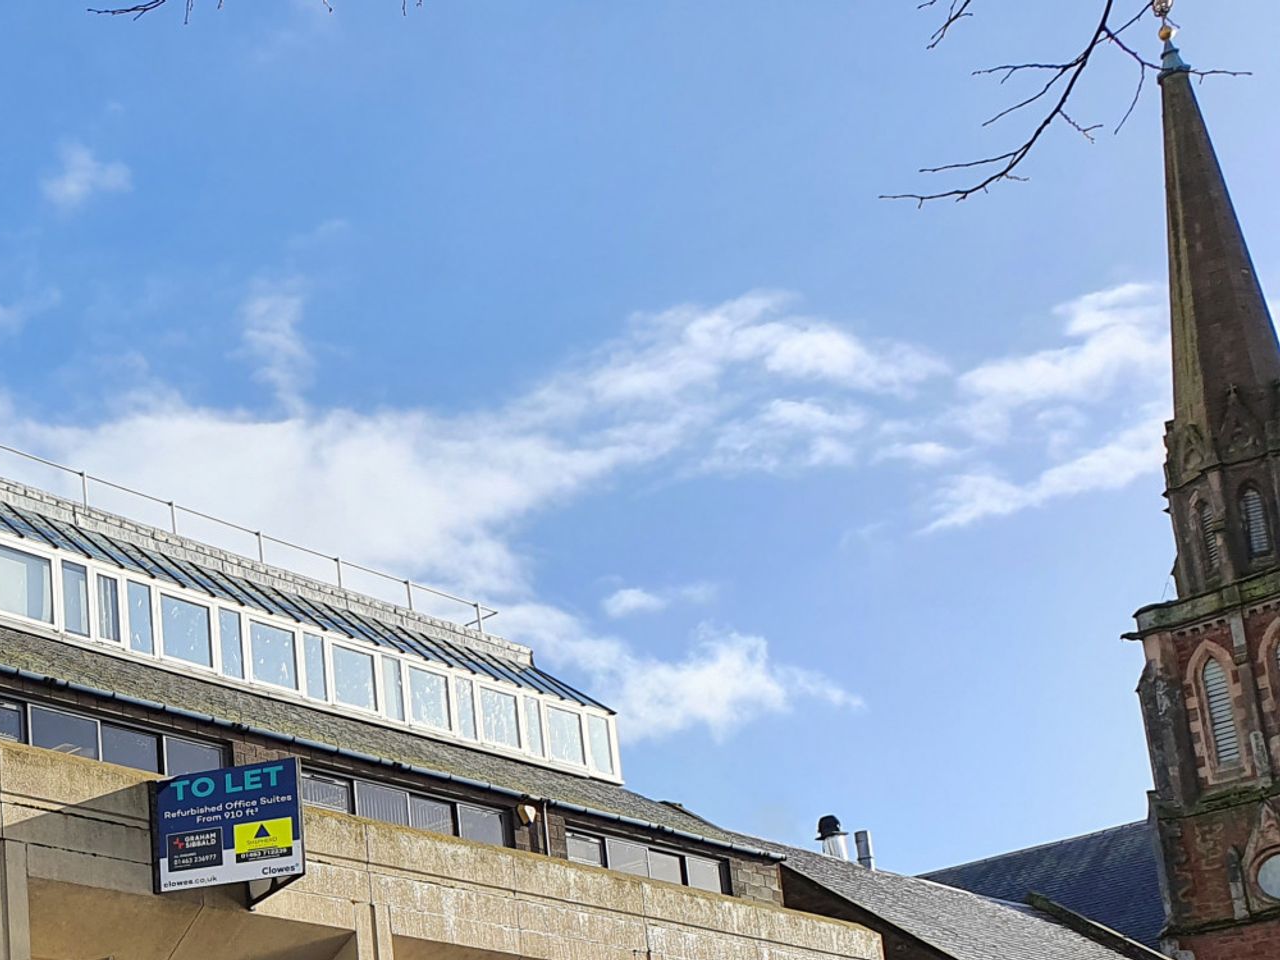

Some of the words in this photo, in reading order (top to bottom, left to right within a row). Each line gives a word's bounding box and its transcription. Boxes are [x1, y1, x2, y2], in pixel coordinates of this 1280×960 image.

[170, 778, 215, 801] TO
[225, 765, 284, 794] LET
[164, 803, 223, 820] Refurbished
[224, 799, 258, 810] Office
[260, 794, 292, 805] Suites
[196, 814, 222, 824] From
[224, 810, 244, 820] 910
[185, 832, 216, 842] GRAHAM
[246, 836, 278, 844] SHEPHERD
[185, 839, 216, 848] SIBBALD
[262, 865, 296, 875] Clowes
[164, 874, 218, 888] clowes.co.uk
